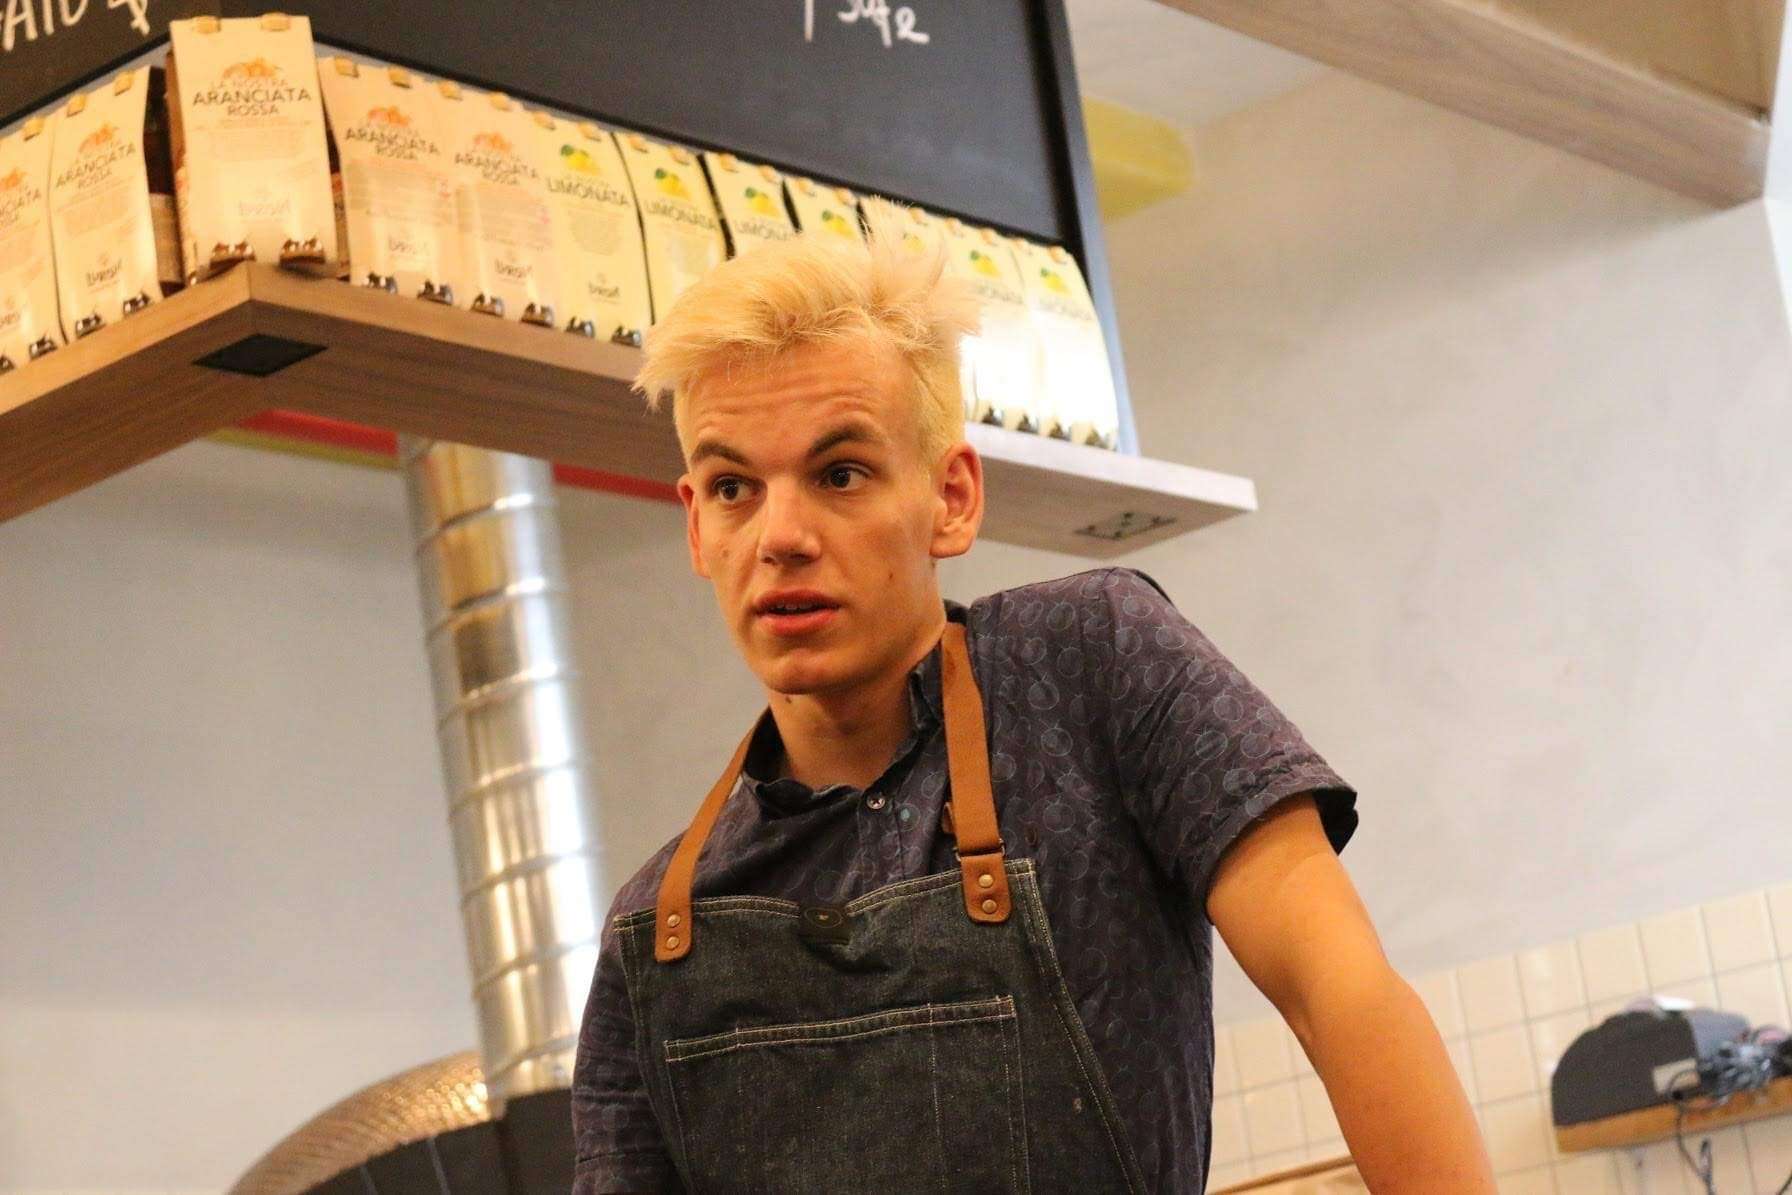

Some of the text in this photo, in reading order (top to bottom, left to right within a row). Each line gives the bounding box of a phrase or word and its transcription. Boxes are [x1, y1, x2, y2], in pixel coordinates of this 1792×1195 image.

[193, 88, 312, 106] ARANCIATA
[227, 104, 280, 116] ROSSA
[56, 141, 136, 188] ARANCIATA
